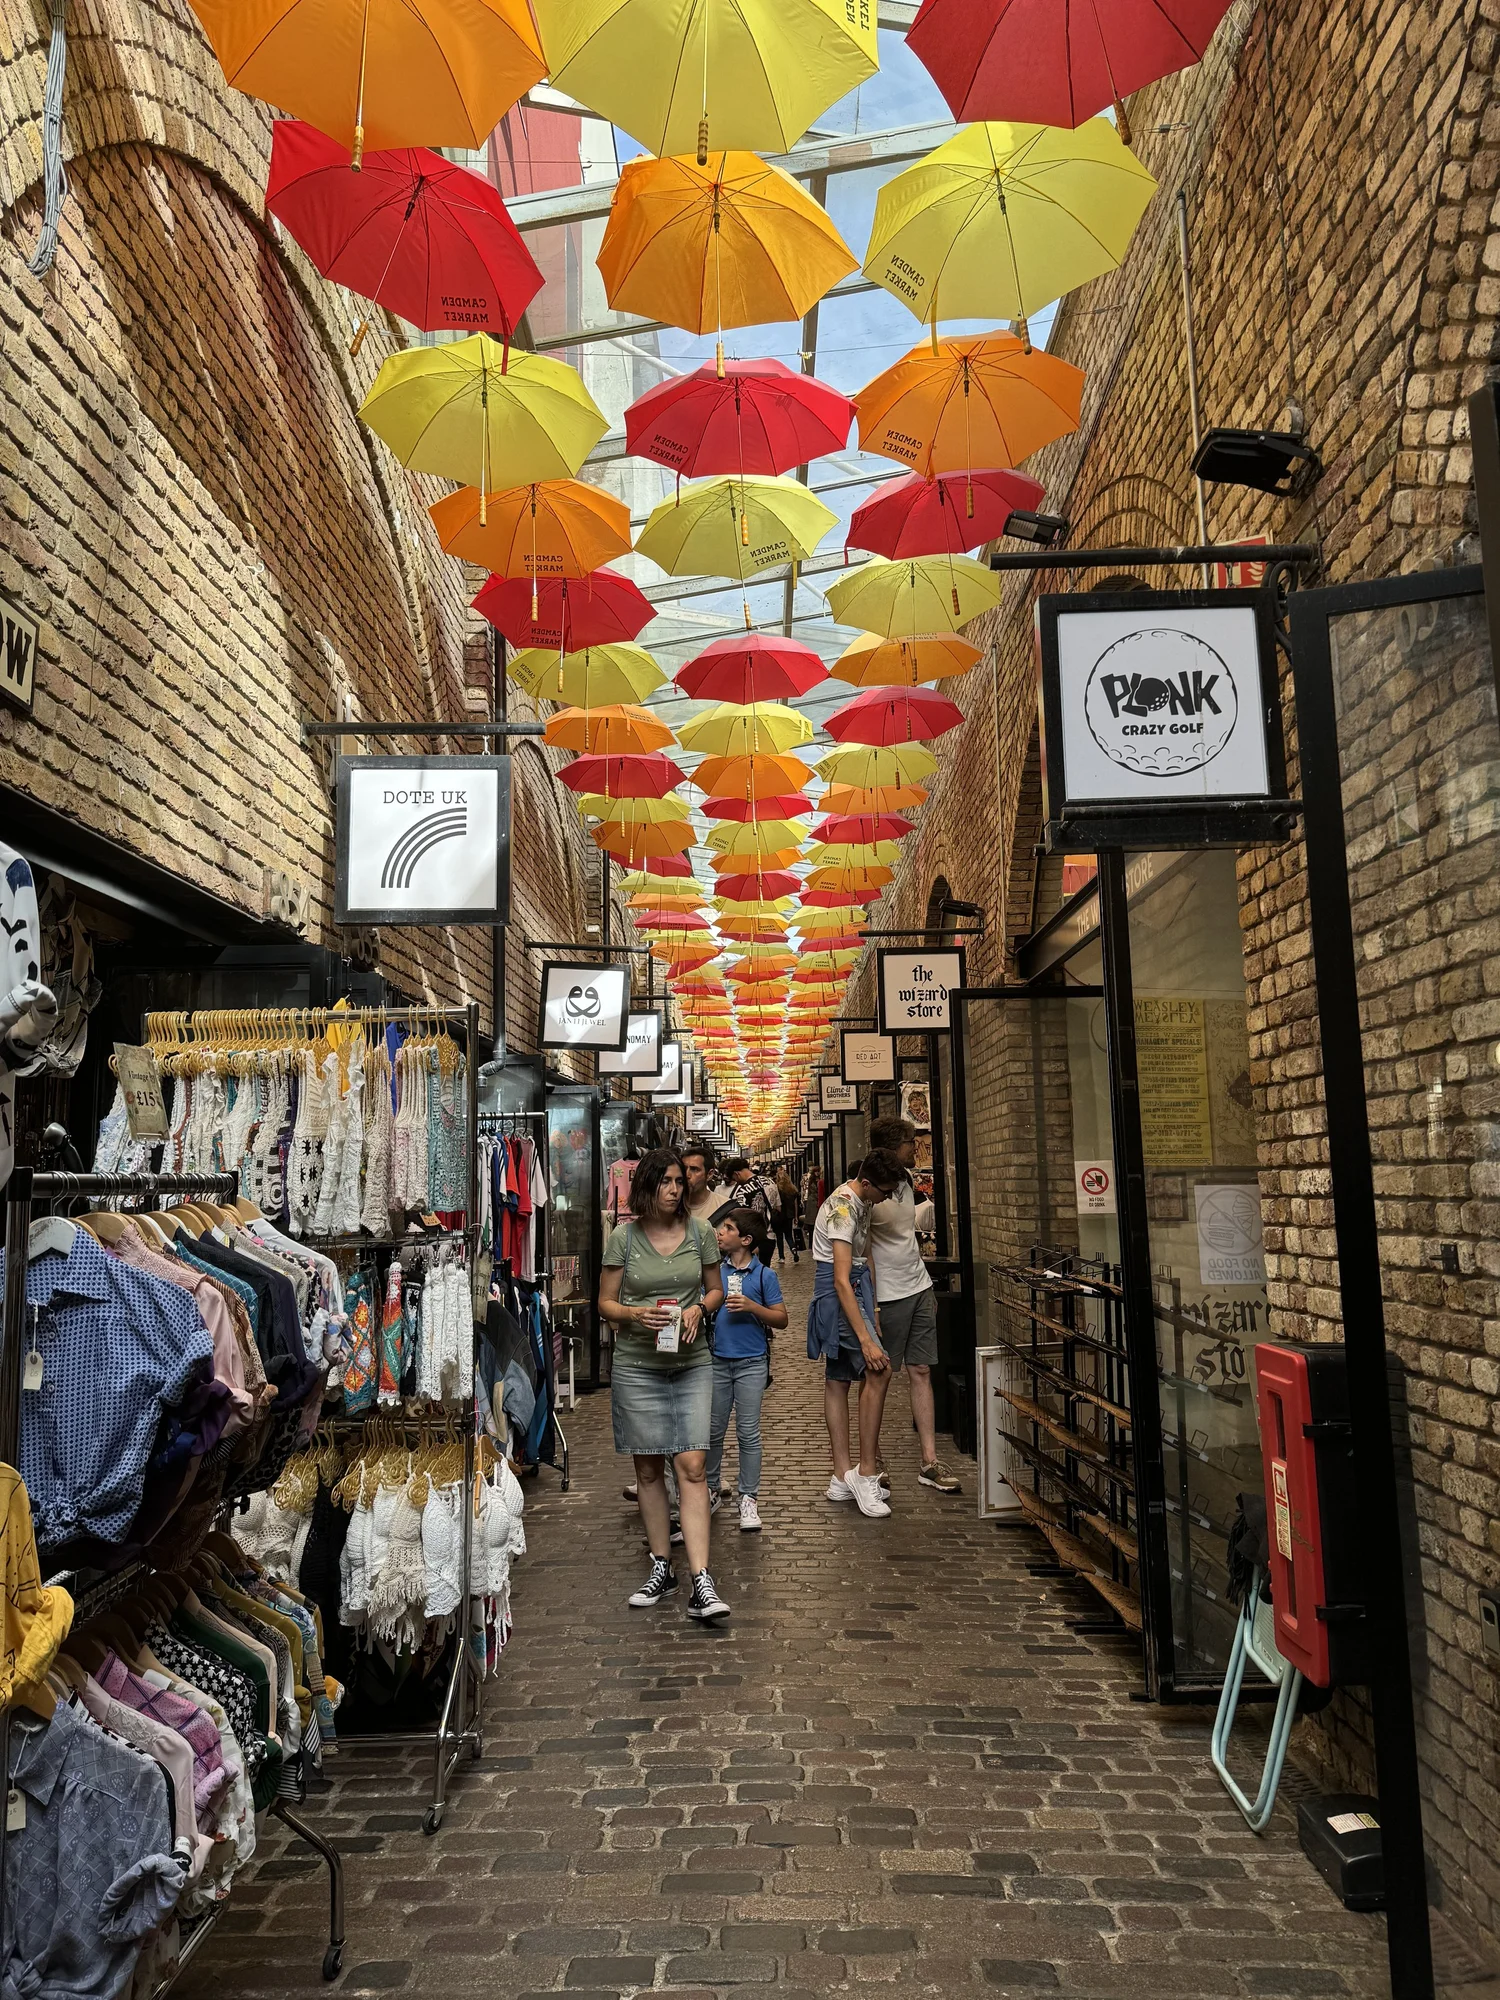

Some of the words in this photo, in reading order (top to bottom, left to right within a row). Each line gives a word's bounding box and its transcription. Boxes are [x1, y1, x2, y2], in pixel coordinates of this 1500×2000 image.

[1100, 670, 1222, 718] PLONK
[1122, 724, 1166, 736] CRAZY
[1169, 723, 1204, 735] GOLF
[383, 790, 434, 804] DOTE
[441, 790, 467, 804] UK
[1077, 909, 1090, 937] THE
[912, 964, 933, 987] the
[898, 984, 948, 1002] wizard
[907, 1002, 943, 1018] store
[136, 1090, 156, 1107] £15
[1196, 1341, 1246, 1381] sto
